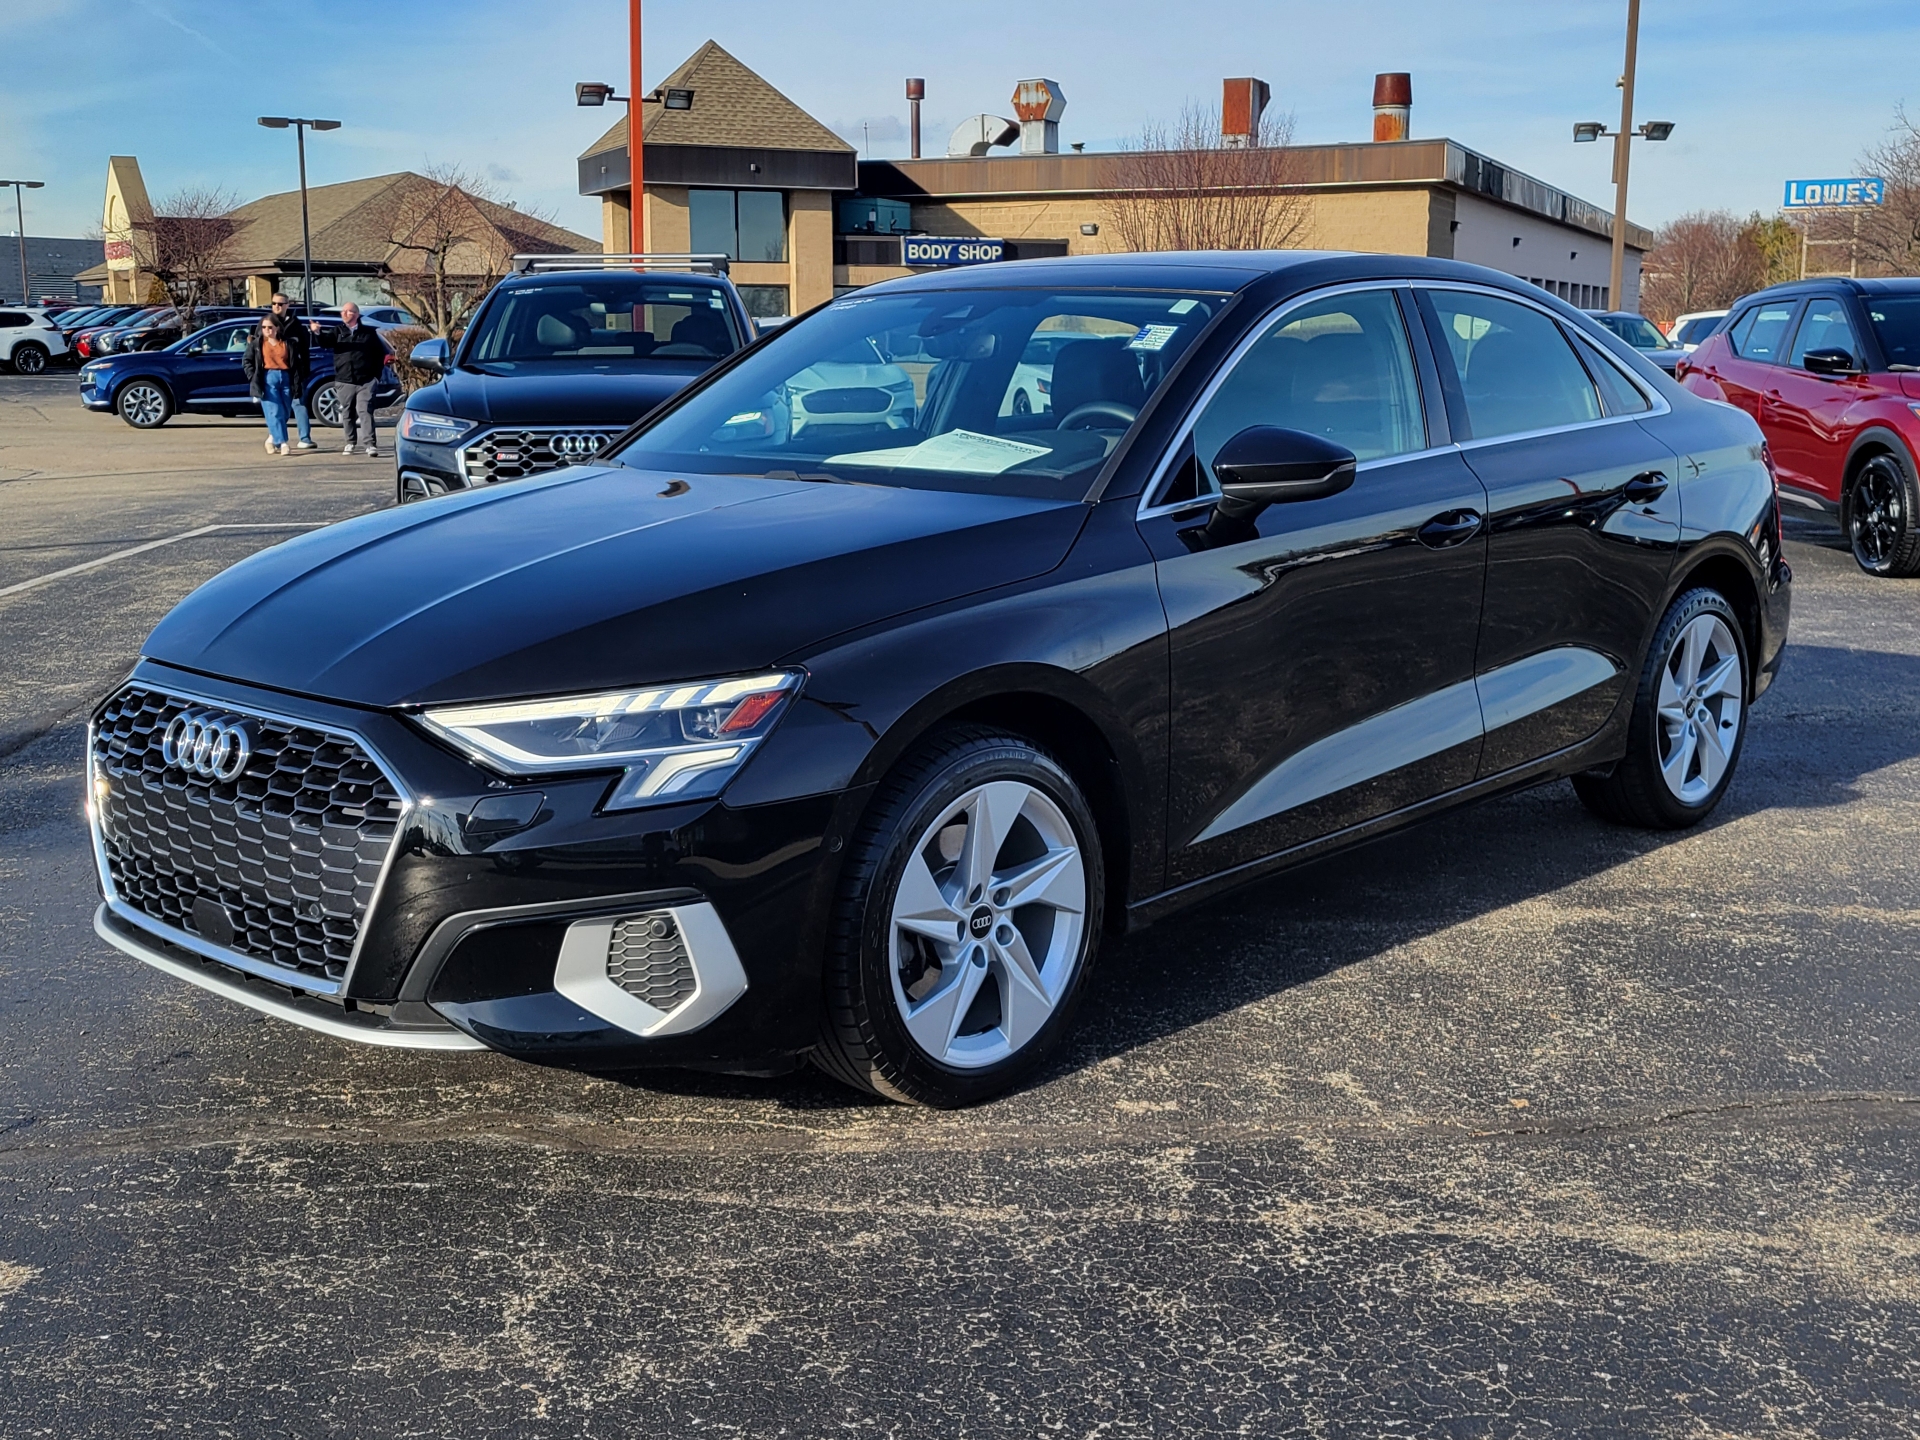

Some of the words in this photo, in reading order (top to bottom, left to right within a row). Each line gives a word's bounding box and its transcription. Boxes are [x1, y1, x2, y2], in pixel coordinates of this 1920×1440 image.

[1789, 181, 1879, 205] LOWE'S
[907, 243, 951, 260] BODY
[958, 244, 1002, 261] SHOP
